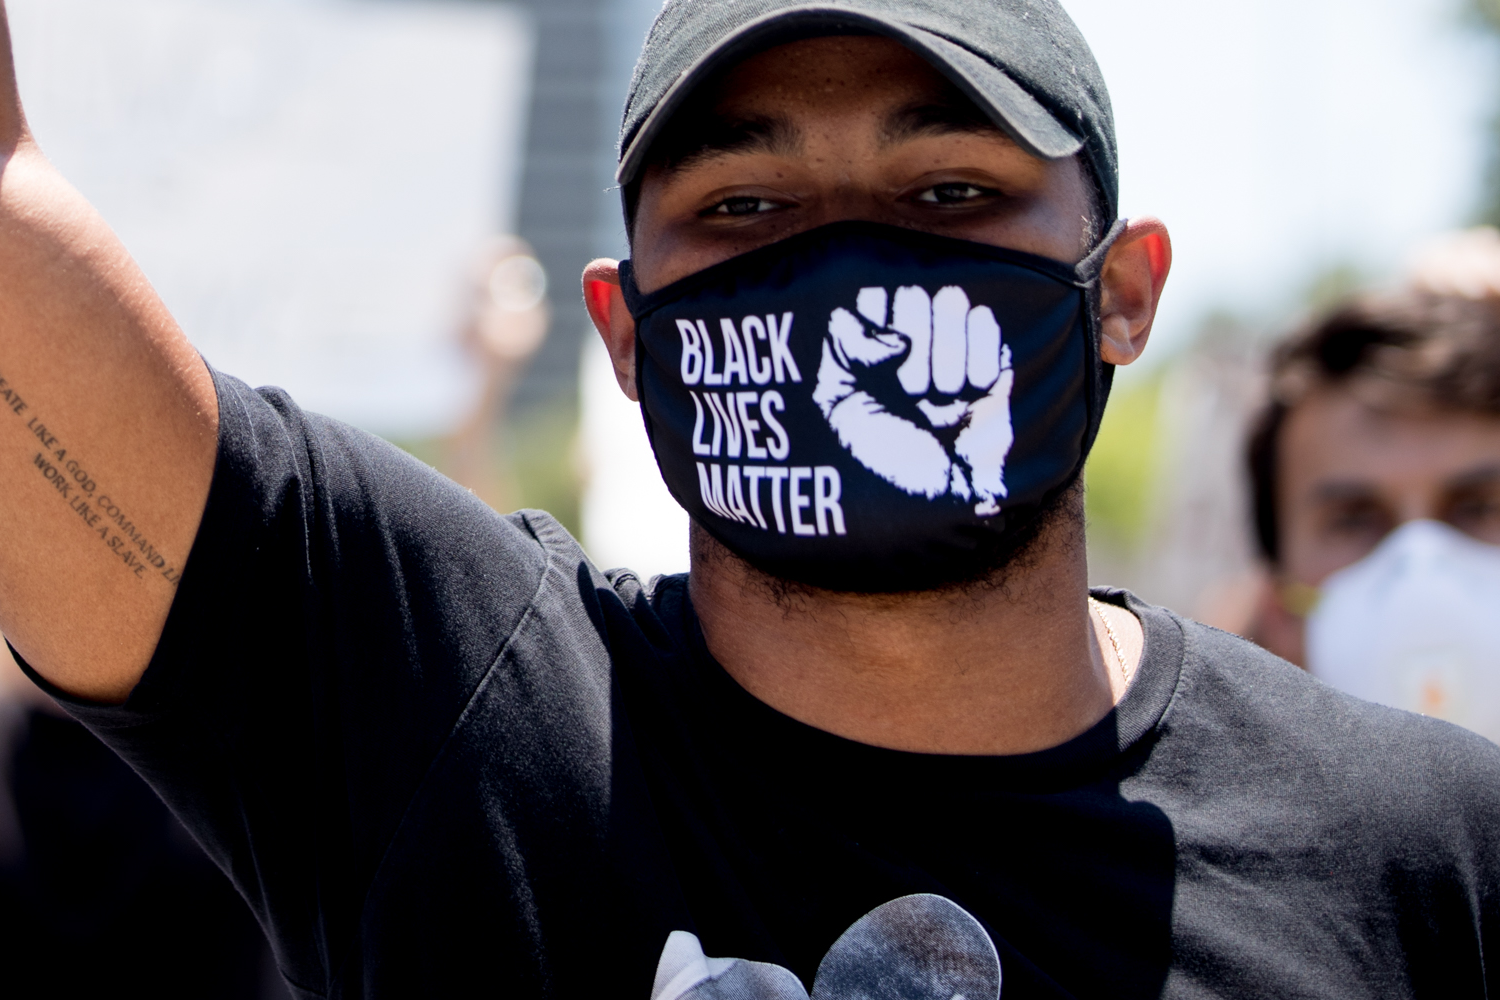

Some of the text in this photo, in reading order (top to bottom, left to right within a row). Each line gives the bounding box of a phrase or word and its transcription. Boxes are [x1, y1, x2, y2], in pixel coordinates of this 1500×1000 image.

[675, 311, 802, 386] BLACK
[689, 390, 790, 460] LIVES
[27, 416, 58, 450] LIKE
[53, 448, 67, 463] A
[66, 460, 97, 498] GOD,
[97, 495, 165, 569] COMMAND
[162, 568, 181, 587] LI
[32, 452, 148, 579] WORK LIKE A SLAVE
[696, 461, 847, 536] MATTER
